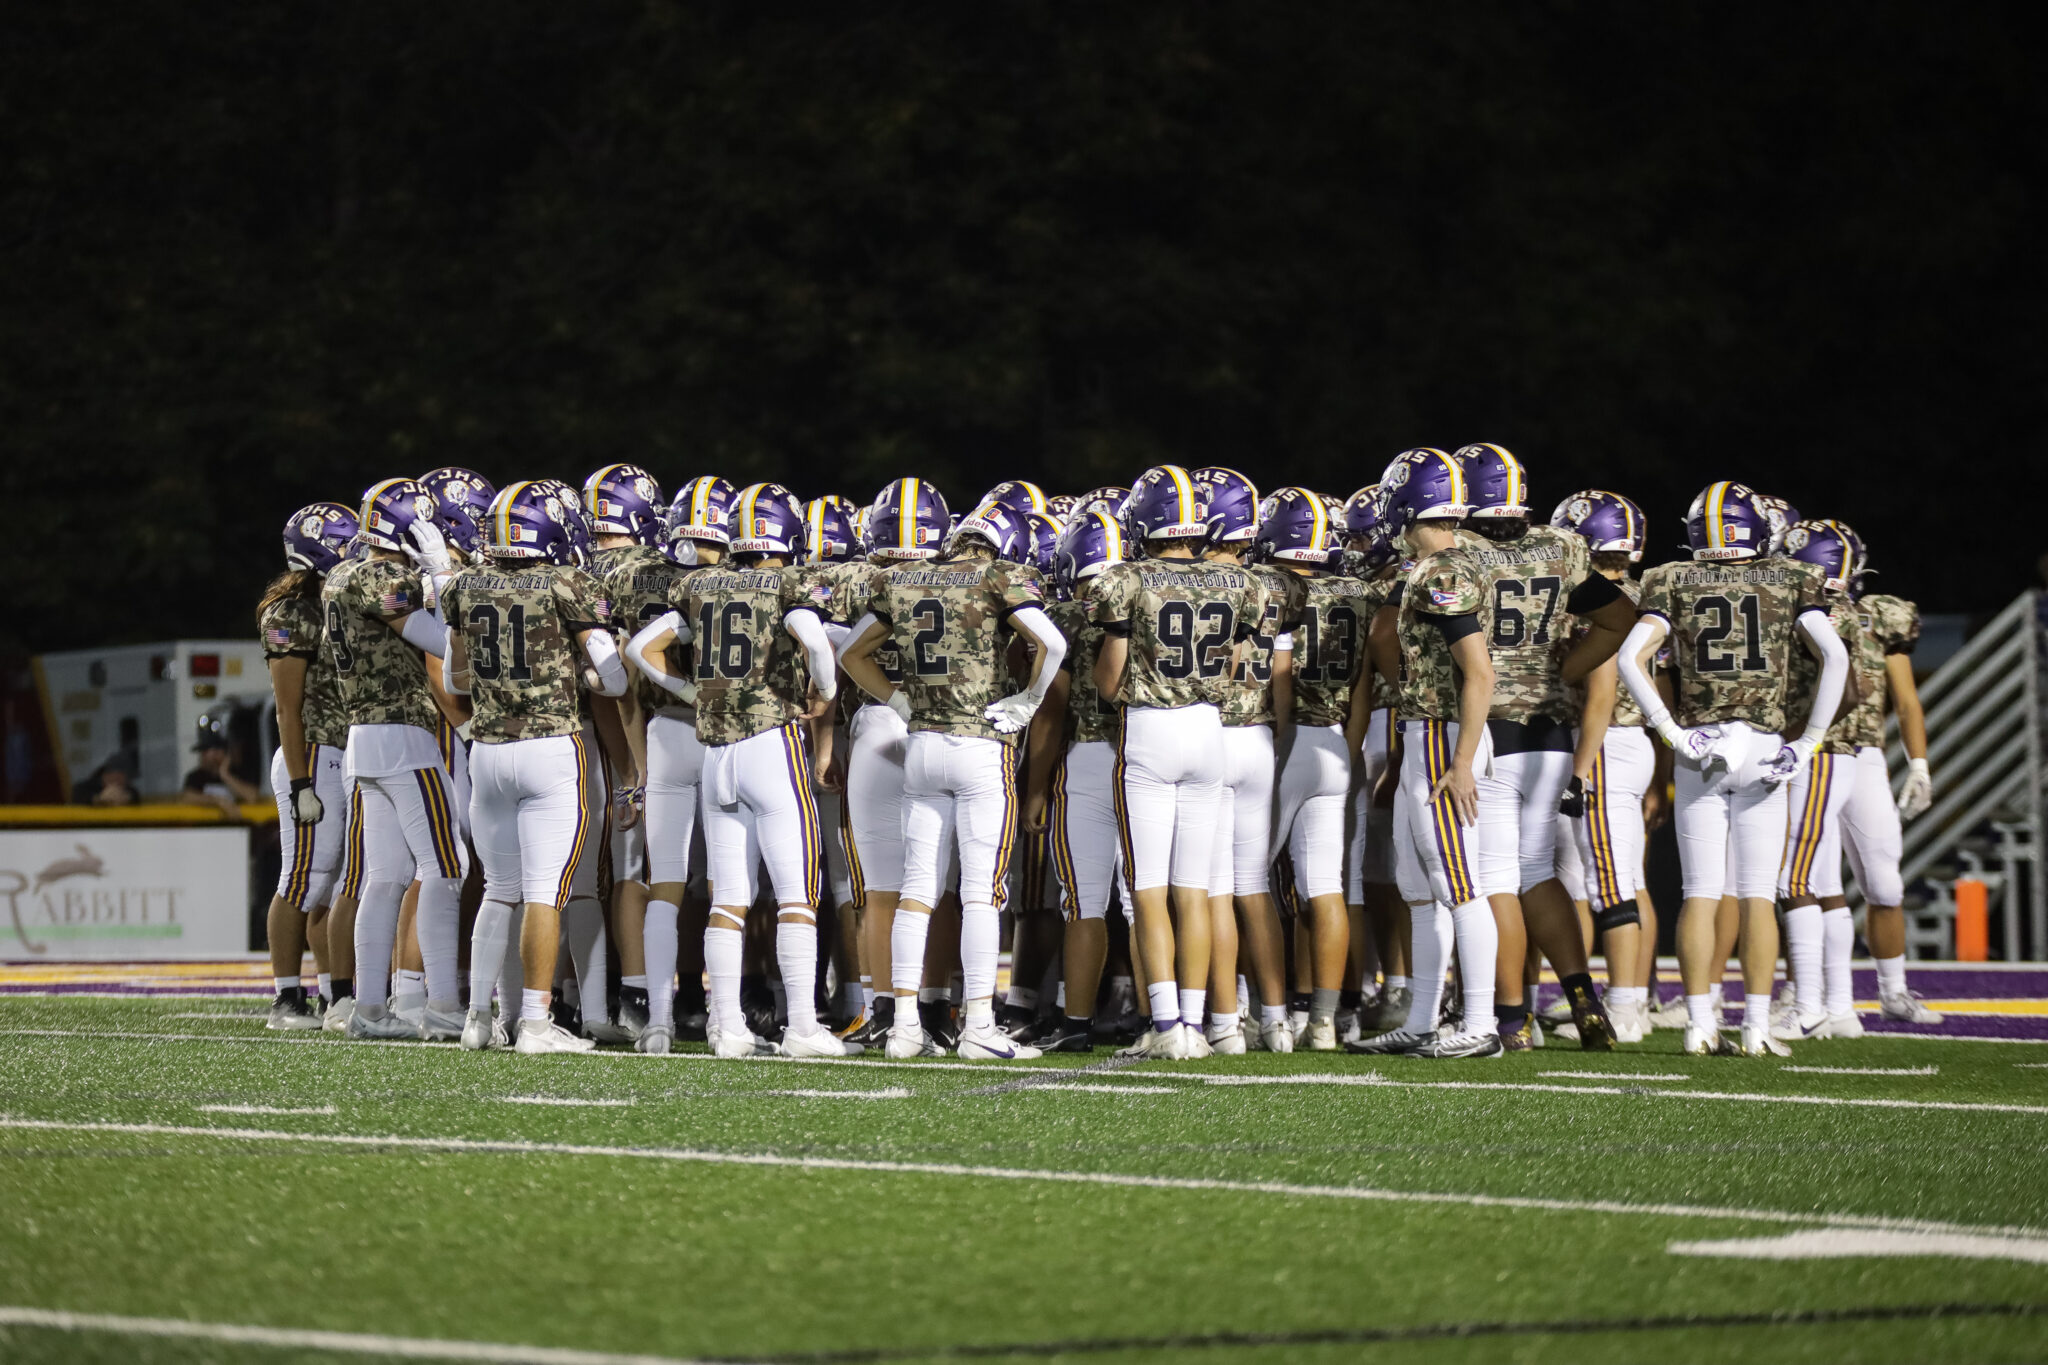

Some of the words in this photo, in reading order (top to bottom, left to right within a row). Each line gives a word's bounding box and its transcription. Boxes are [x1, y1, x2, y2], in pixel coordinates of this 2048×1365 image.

[438, 469, 485, 491] JHS
[679, 527, 718, 539] Riddell
[1168, 525, 1204, 537] Riddell
[490, 548, 526, 557] Riddell
[732, 541, 770, 552] Riddell
[887, 549, 927, 559] Riddell
[1699, 549, 1739, 560] Riddell
[510, 575, 551, 590] GUARD
[740, 573, 780, 590] GUARD
[891, 571, 942, 586] NATIONAL
[945, 571, 982, 585] GUARD
[1142, 571, 1203, 588] NATIONAL
[1204, 573, 1246, 588] GUARD
[1674, 570, 1738, 586] NATIONAL
[1742, 569, 1785, 584] GUARD
[1492, 576, 1561, 648] 67
[468, 602, 533, 682] 31
[696, 601, 754, 680] 16
[912, 597, 949, 677] 2
[1156, 600, 1235, 680] 92
[1692, 594, 1769, 674] 21
[1298, 604, 1357, 683] 13
